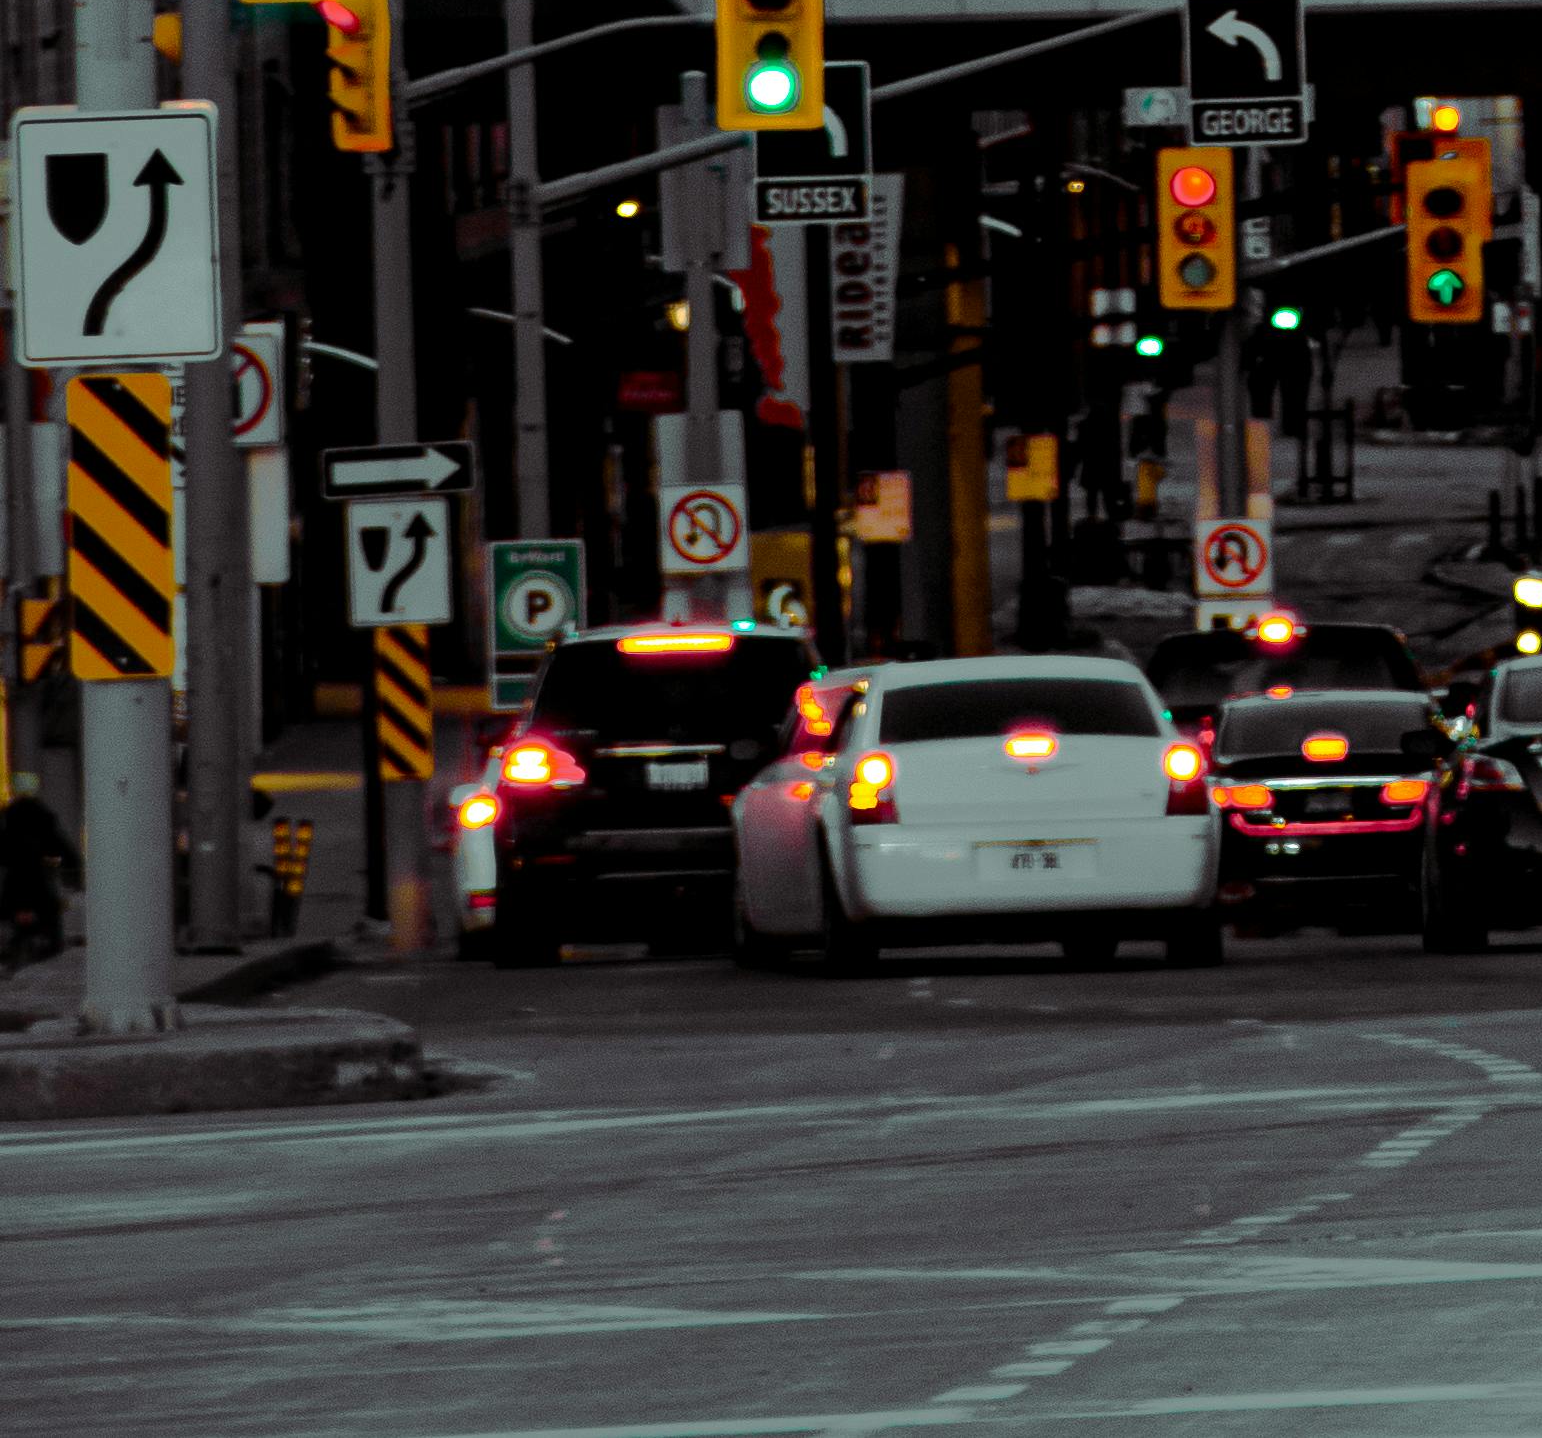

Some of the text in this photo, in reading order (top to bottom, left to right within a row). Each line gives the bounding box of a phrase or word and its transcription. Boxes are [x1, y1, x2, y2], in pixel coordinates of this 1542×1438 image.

[1200, 106, 1295, 137] GEORGE
[765, 186, 856, 215] SUSSEX
[835, 224, 873, 349] RIDea
[527, 589, 554, 624] P
